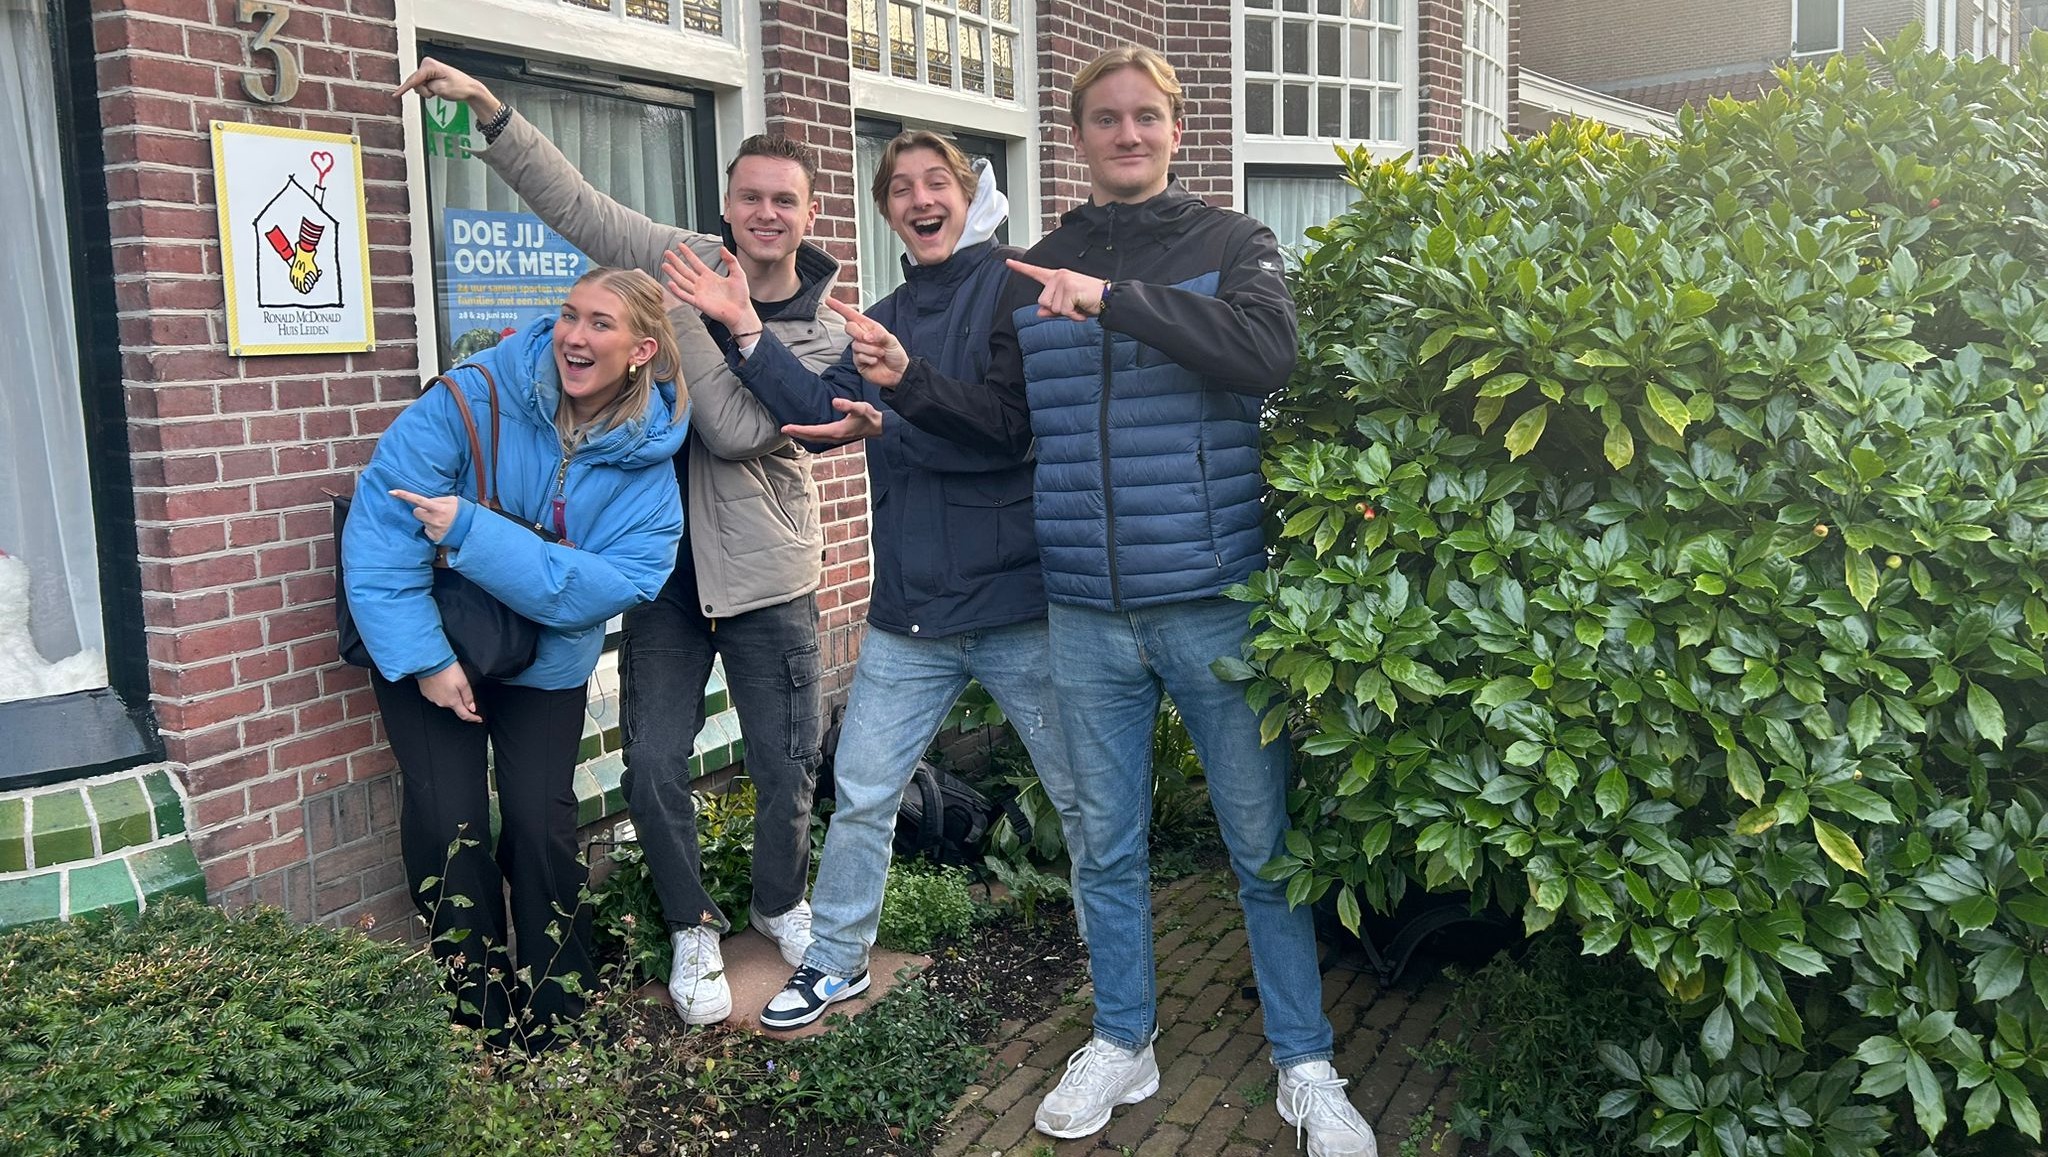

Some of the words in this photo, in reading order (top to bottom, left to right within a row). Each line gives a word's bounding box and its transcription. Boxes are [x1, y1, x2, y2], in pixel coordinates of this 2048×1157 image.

[236, 0, 299, 104] 3
[452, 218, 507, 247] DOE
[512, 223, 544, 248] JIJ
[454, 248, 514, 275] OOK
[518, 251, 579, 276] MEE?
[471, 284, 486, 292] uur
[488, 284, 518, 293] samen
[520, 284, 552, 294] sporten
[458, 295, 495, 305] families
[497, 296, 515, 305] met
[517, 297, 533, 305] een
[534, 296, 551, 306] ziek
[486, 311, 500, 320] juni
[501, 312, 518, 320] 2025
